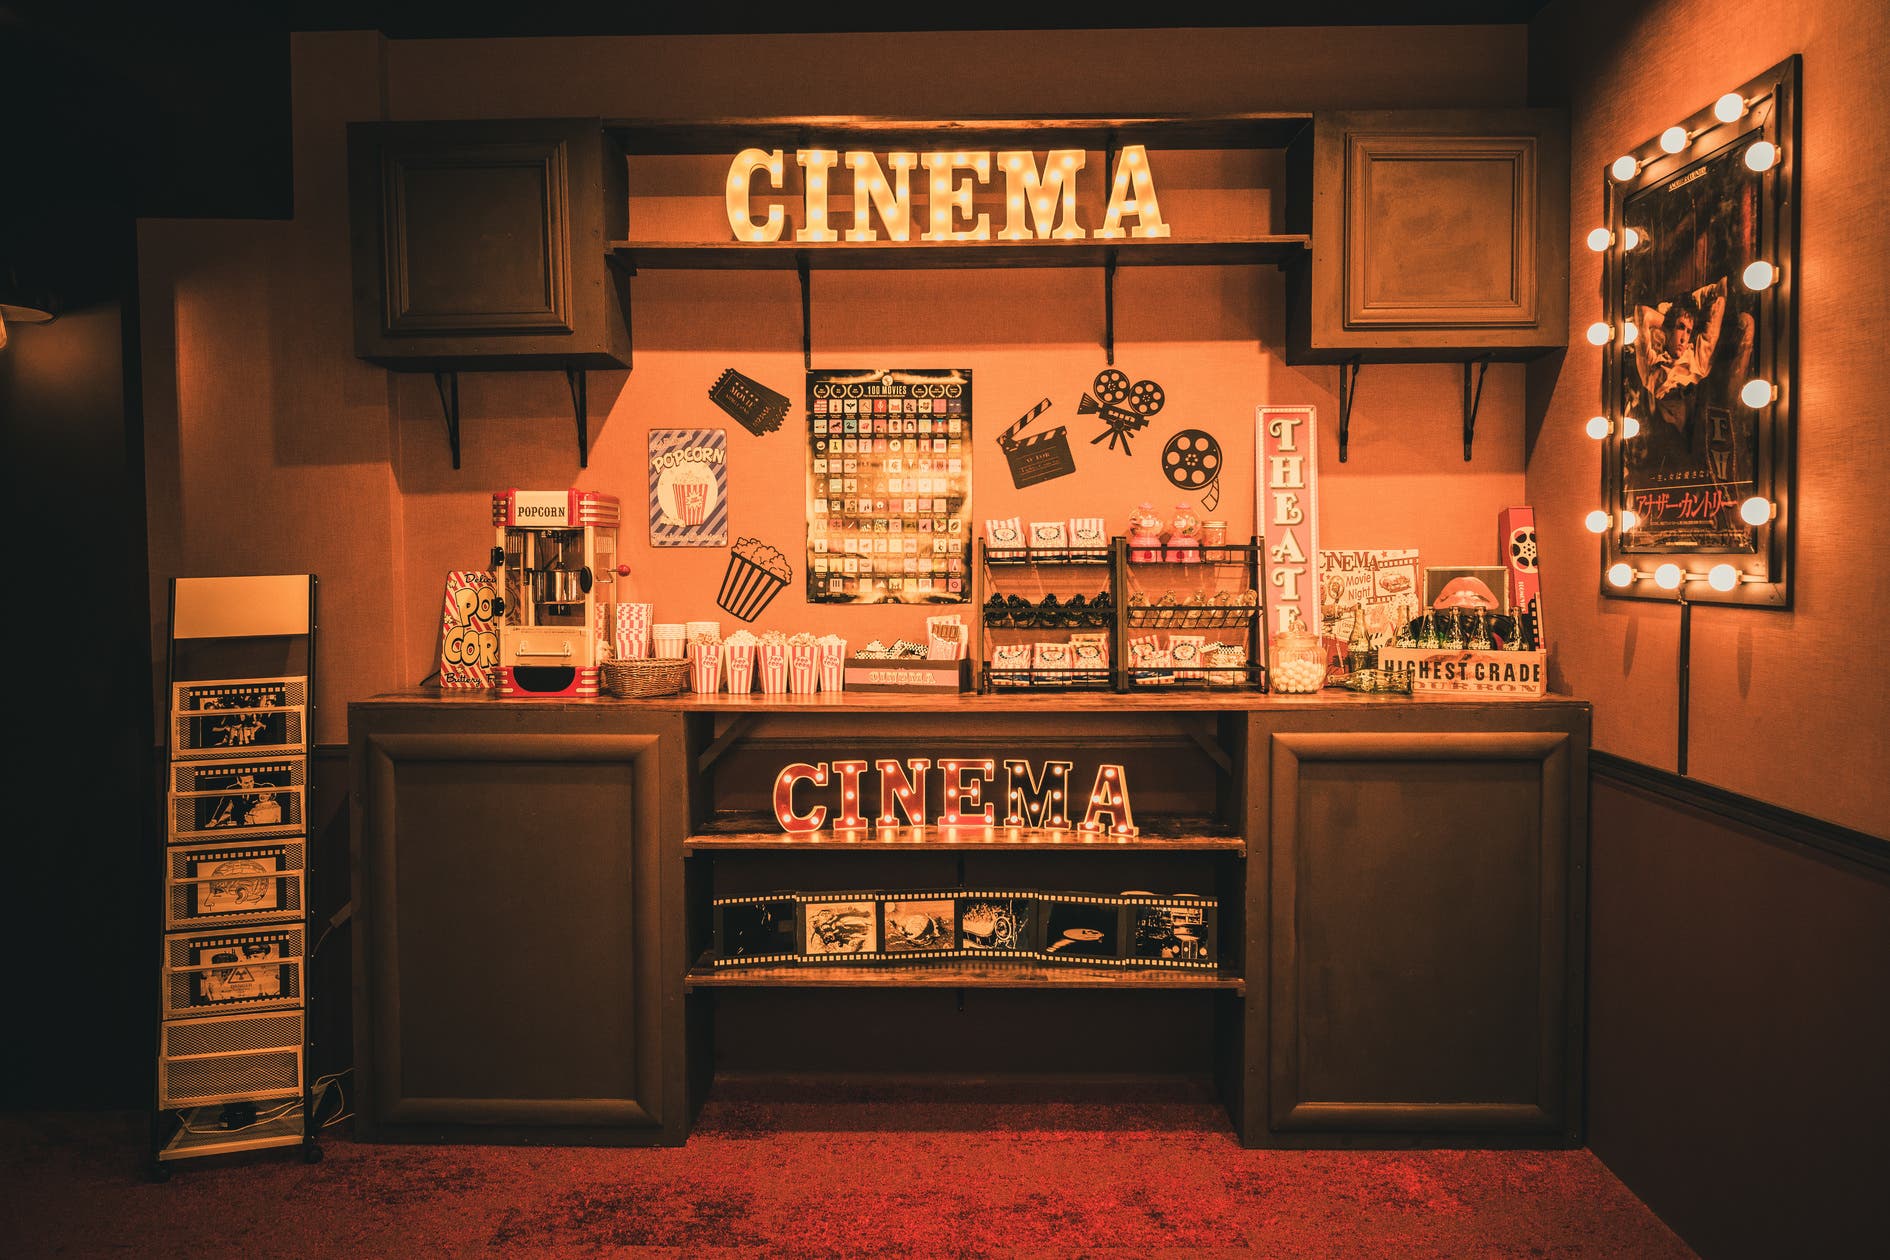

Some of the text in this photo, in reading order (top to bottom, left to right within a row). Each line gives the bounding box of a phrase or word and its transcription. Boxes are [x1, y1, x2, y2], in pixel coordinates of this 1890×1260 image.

[725, 145, 1171, 242] CINEMA
[867, 385, 880, 395] 100
[882, 385, 907, 395] MOVIES
[651, 446, 725, 474] POPCORN
[517, 506, 566, 518] POPCORN
[1269, 418, 1307, 633] THEATE
[1318, 551, 1380, 571] CINEMA
[1346, 574, 1371, 587] Movie
[1348, 586, 1371, 600] Night
[444, 626, 499, 668] COR
[445, 672, 481, 687] Buttery
[1385, 660, 1467, 681] HIGHEST
[1475, 663, 1540, 683] GRADE
[773, 758, 1140, 838] CINEMA
